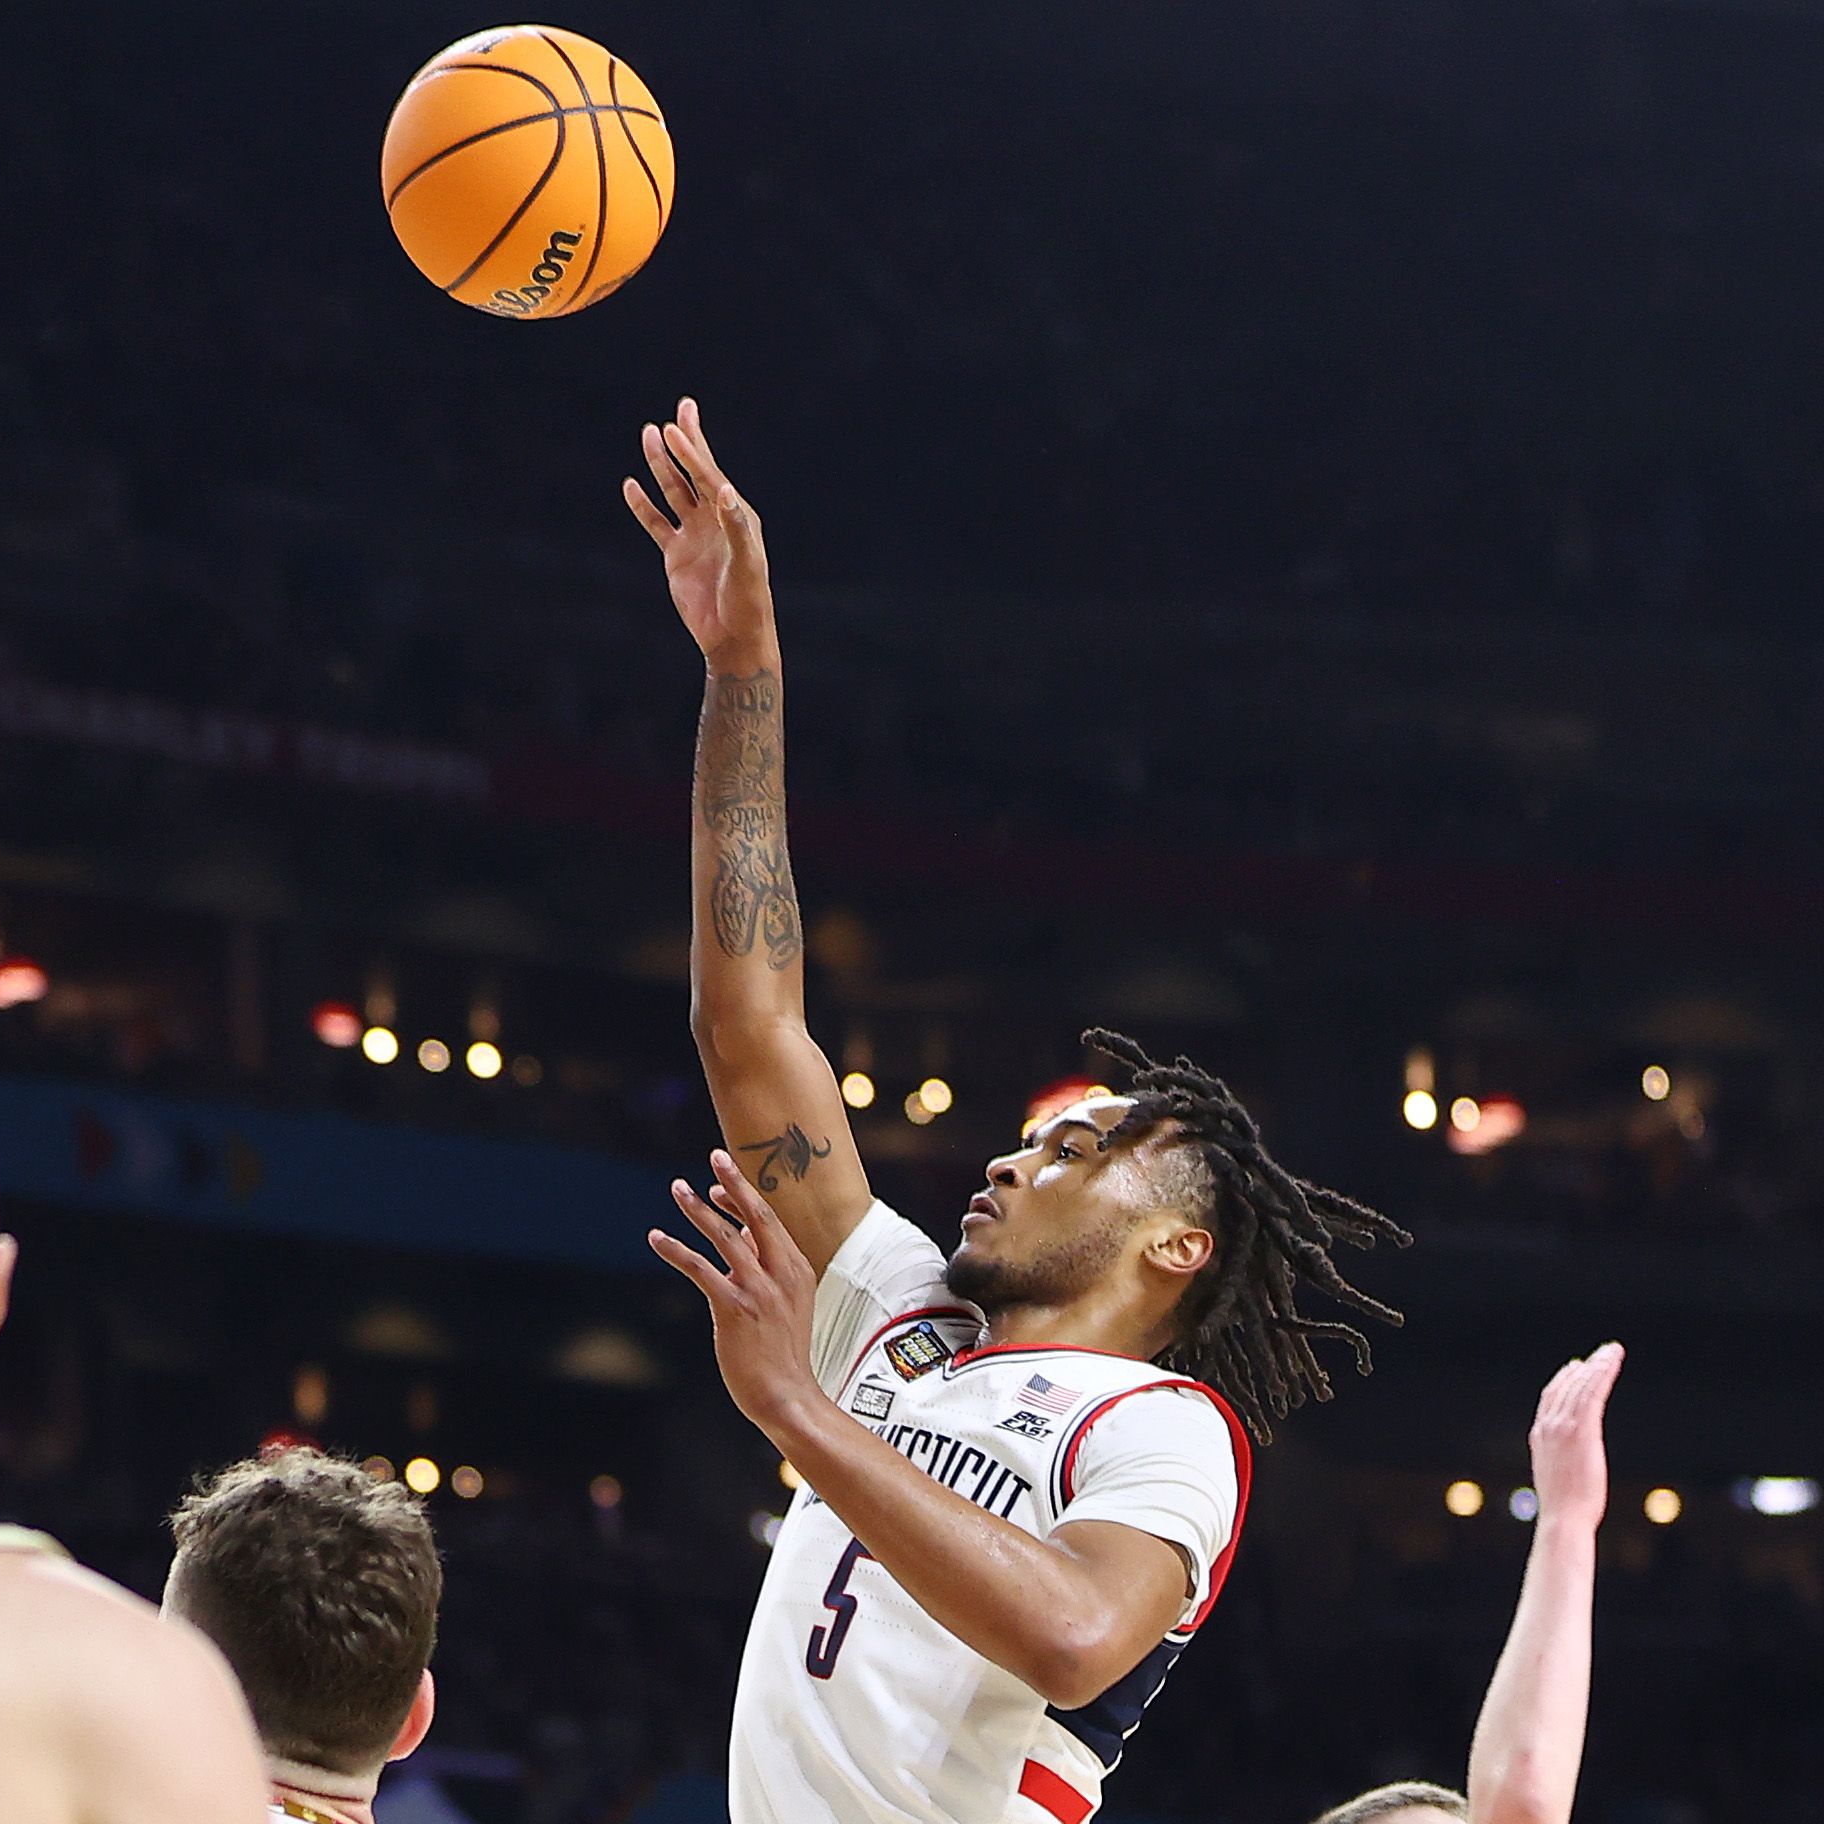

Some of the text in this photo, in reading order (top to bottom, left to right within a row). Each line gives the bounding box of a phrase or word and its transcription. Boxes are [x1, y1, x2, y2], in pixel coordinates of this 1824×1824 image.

[1002, 1418, 1055, 1440] EAST
[1013, 1410, 1051, 1427] BIG
[805, 1537, 882, 1681] 5
